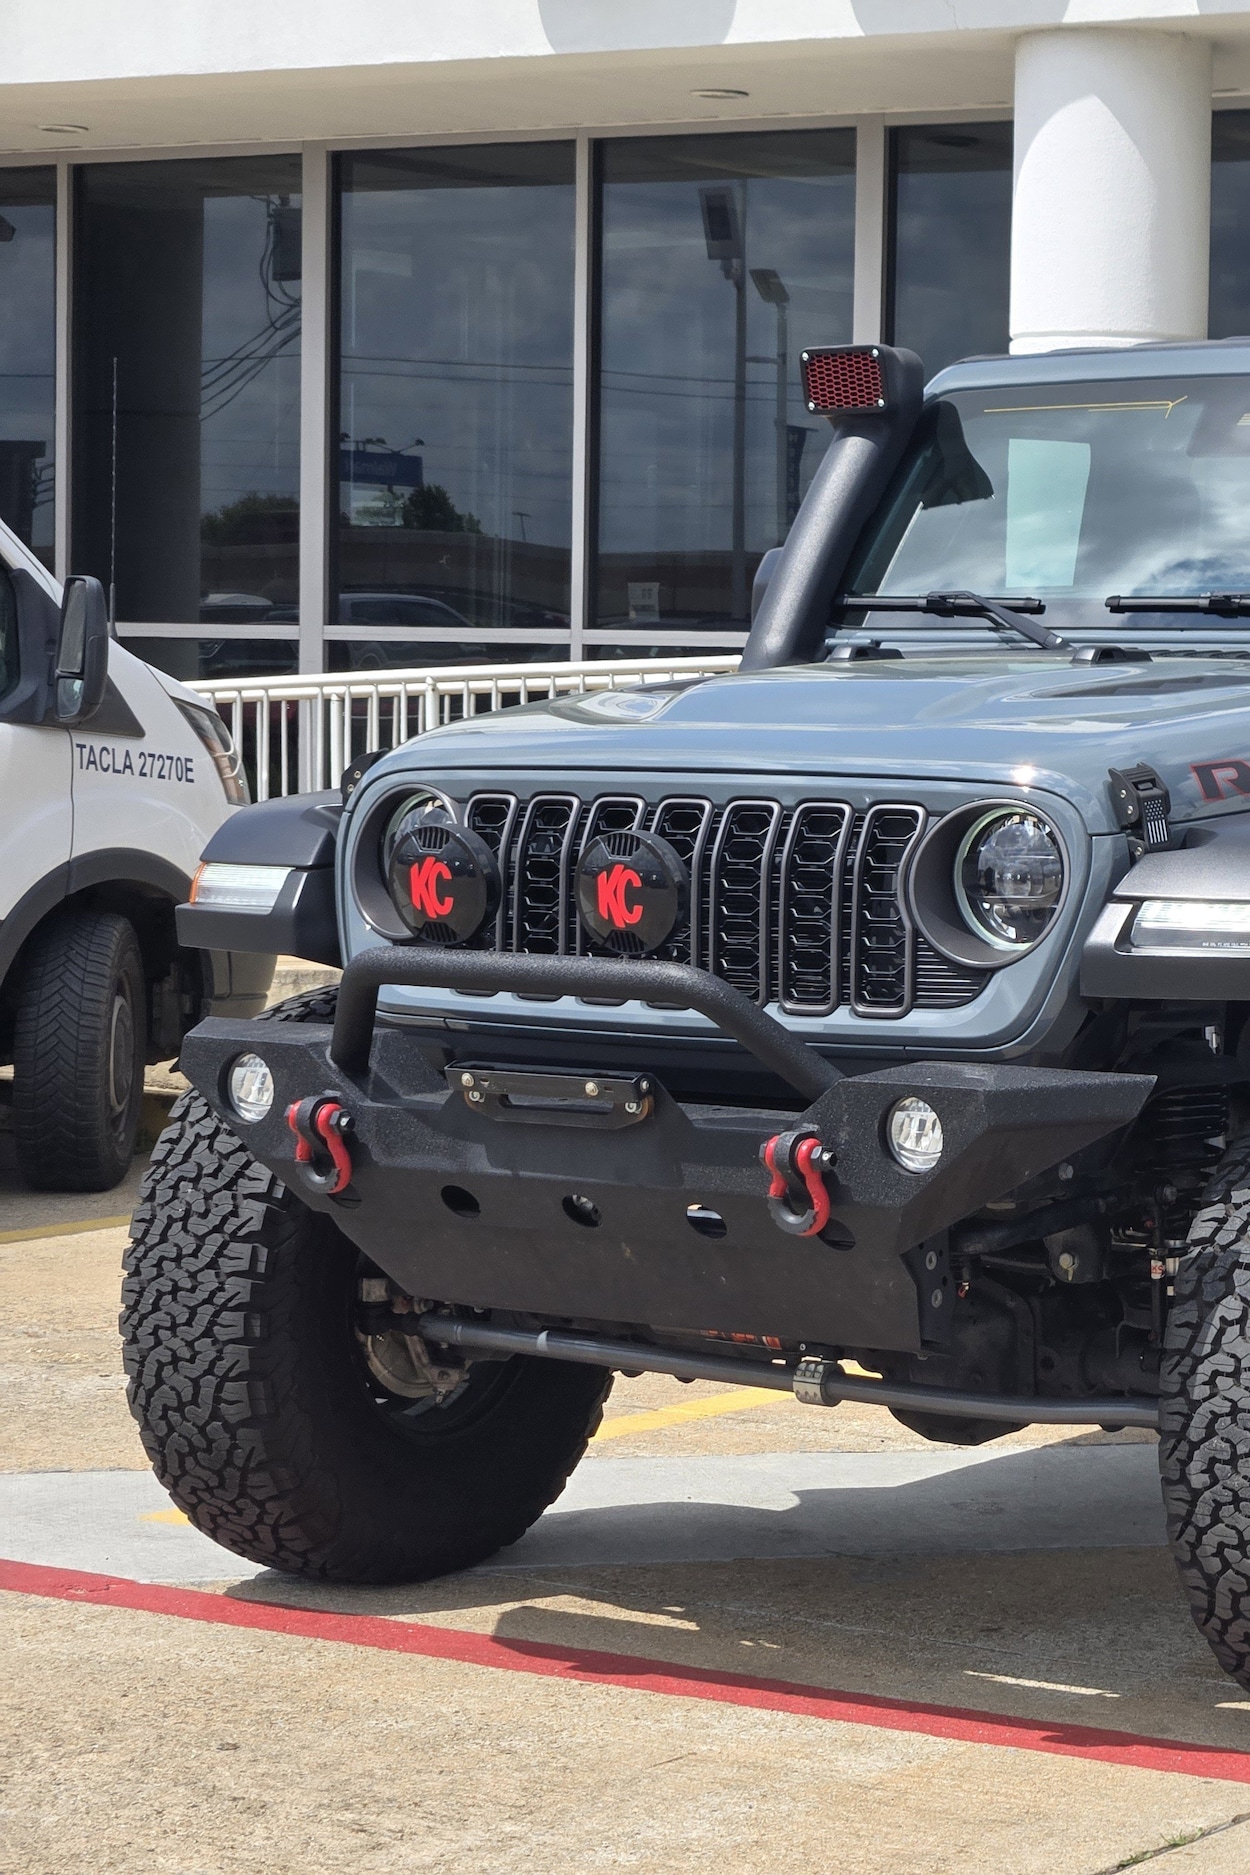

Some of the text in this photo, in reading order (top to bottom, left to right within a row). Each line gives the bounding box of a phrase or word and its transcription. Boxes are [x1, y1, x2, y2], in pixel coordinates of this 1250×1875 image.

[75, 743, 195, 783] TACLA 27270E
[410, 856, 454, 918] KC
[597, 864, 643, 928] KC
